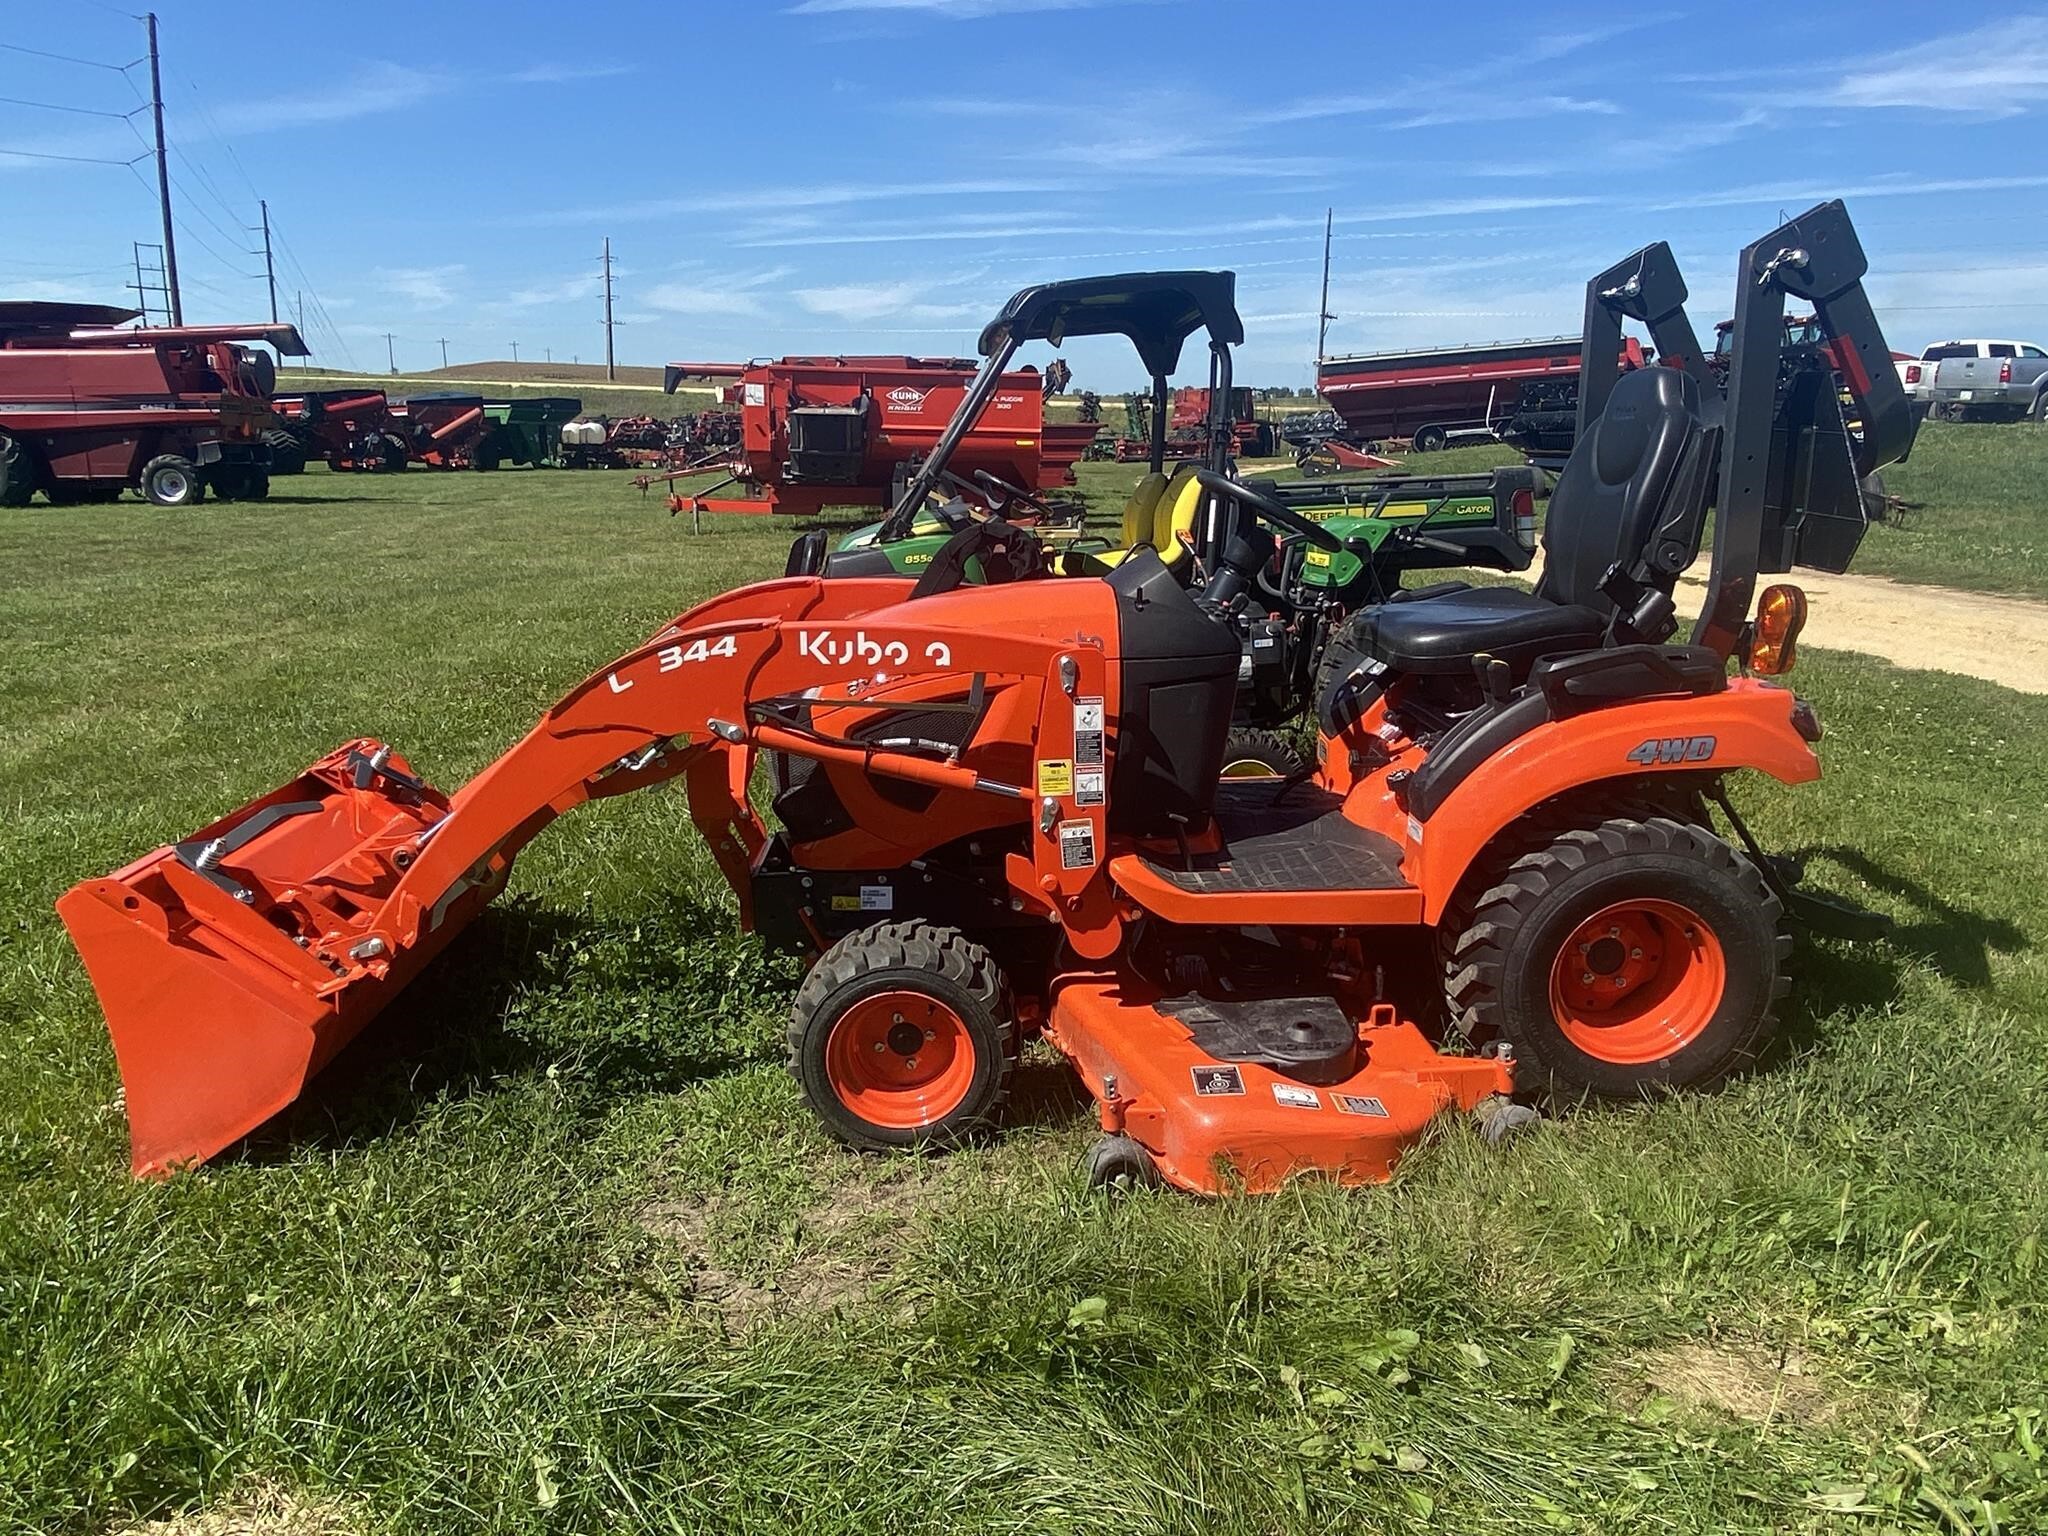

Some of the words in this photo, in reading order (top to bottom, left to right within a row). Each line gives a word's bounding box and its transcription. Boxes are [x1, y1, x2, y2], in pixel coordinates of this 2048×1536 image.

[891, 391, 919, 401] KUHN
[1456, 505, 1492, 514] GATOR
[799, 631, 951, 666] Kuboa
[1626, 735, 1718, 766] 4WD
